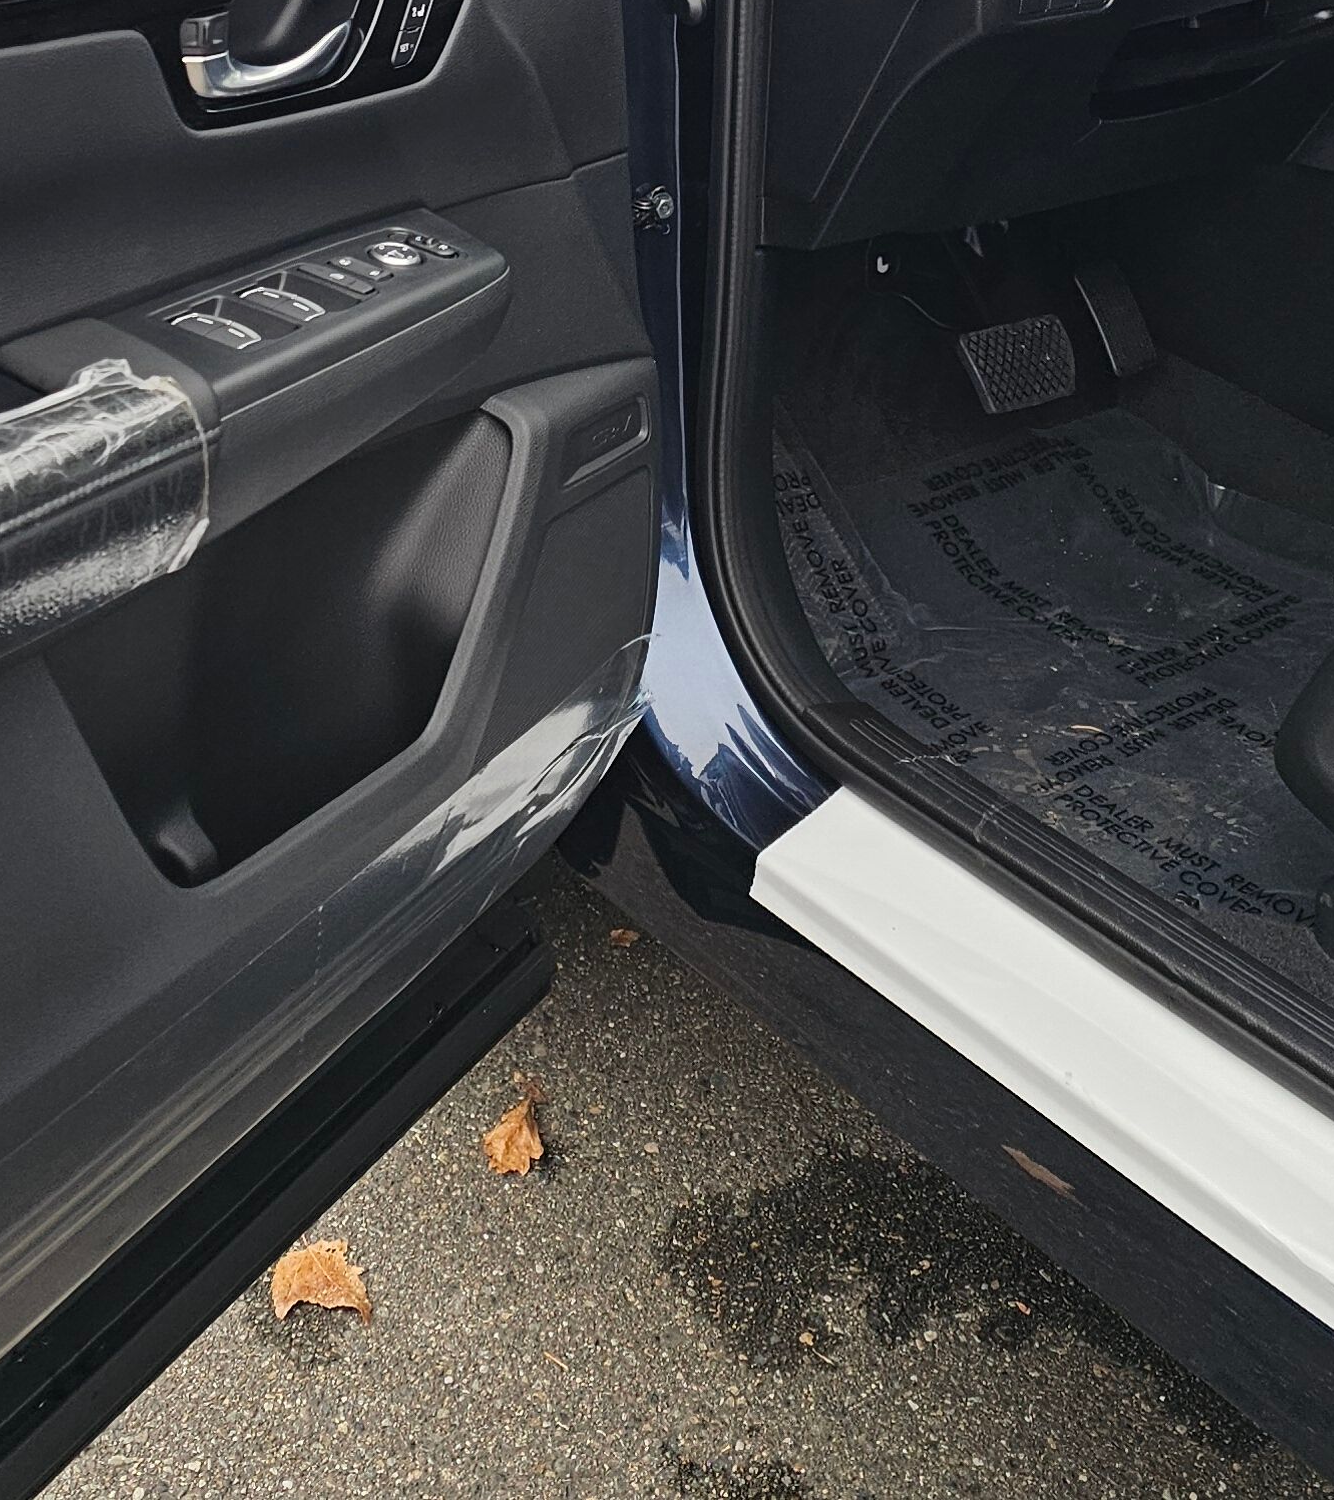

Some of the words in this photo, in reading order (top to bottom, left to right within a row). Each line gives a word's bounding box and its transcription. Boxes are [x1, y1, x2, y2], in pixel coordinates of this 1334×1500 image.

[943, 514, 1001, 580] DEALER
[1054, 793, 1181, 873] PROTECTIVE
[1073, 784, 1154, 834] DEALER
[1158, 836, 1223, 873] MUST
[1224, 873, 1318, 929] REMOV
